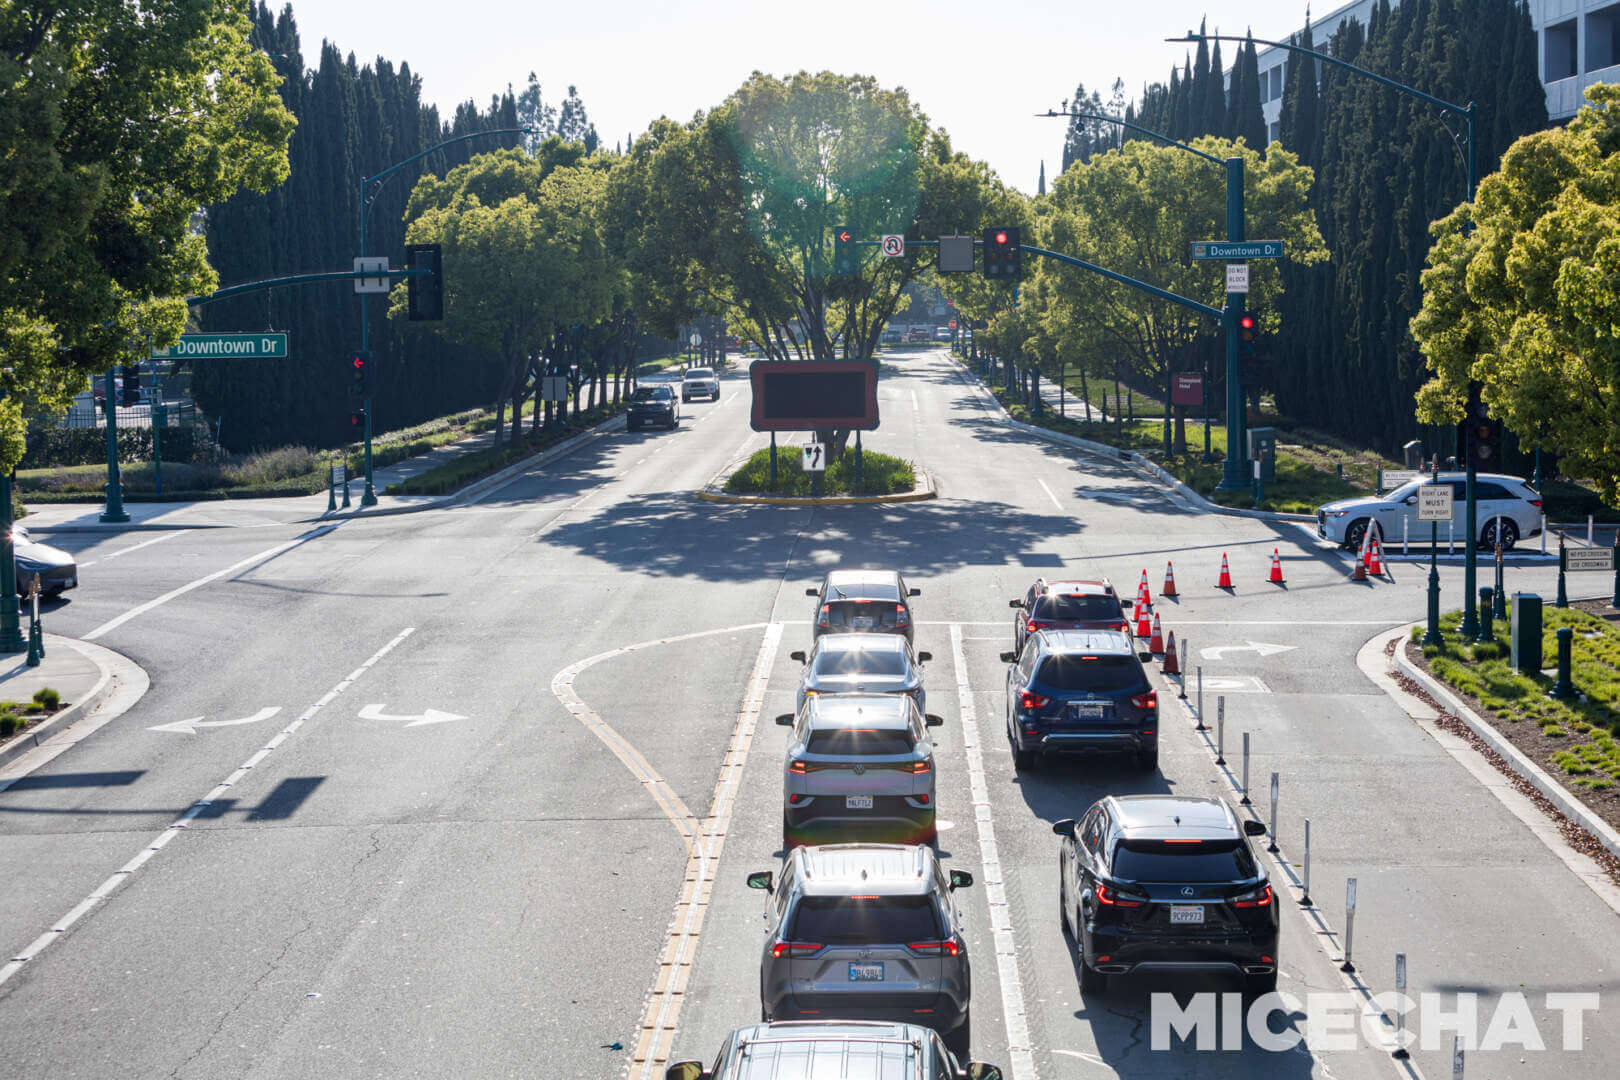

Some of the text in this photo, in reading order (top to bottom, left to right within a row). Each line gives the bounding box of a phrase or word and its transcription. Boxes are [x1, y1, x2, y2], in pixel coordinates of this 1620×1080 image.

[1210, 244, 1276, 256] Downtown Dr
[177, 338, 277, 355] Downtown Dr
[1173, 911, 1202, 921] 9CPP973
